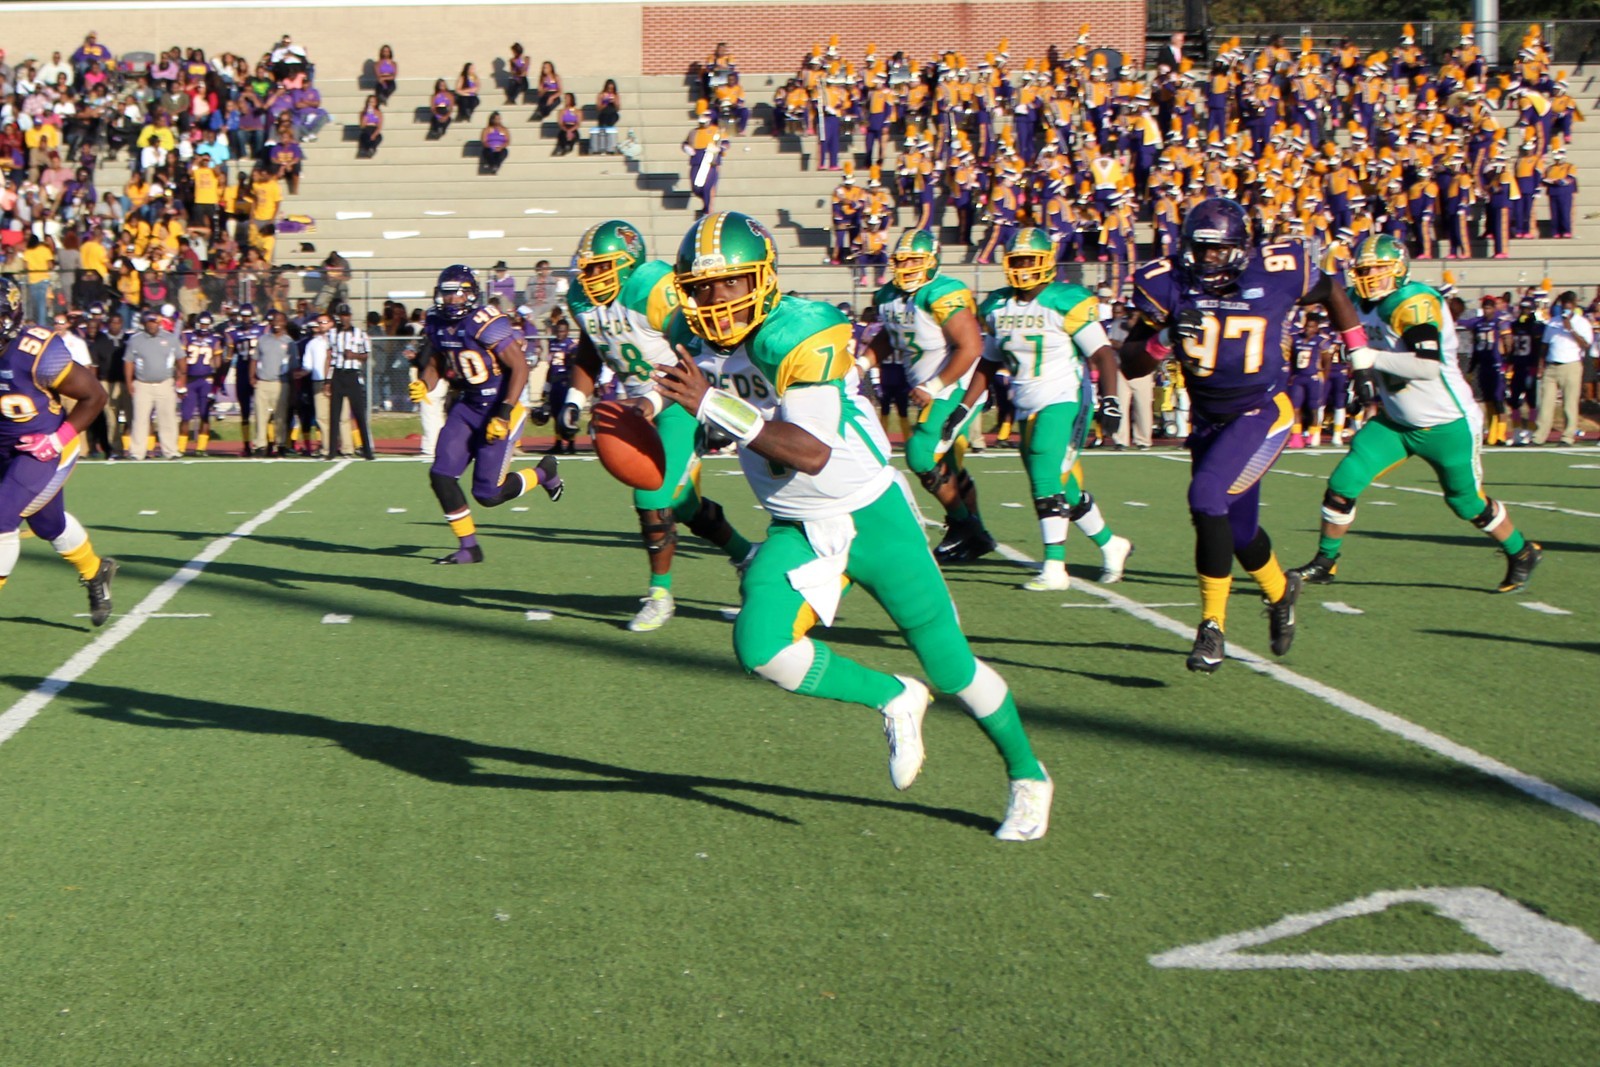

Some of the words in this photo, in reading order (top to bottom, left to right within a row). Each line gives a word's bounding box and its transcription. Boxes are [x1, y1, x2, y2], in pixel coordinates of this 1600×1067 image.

[473, 305, 500, 324] 40
[812, 344, 836, 382] 7
[1181, 314, 1268, 378] 97
